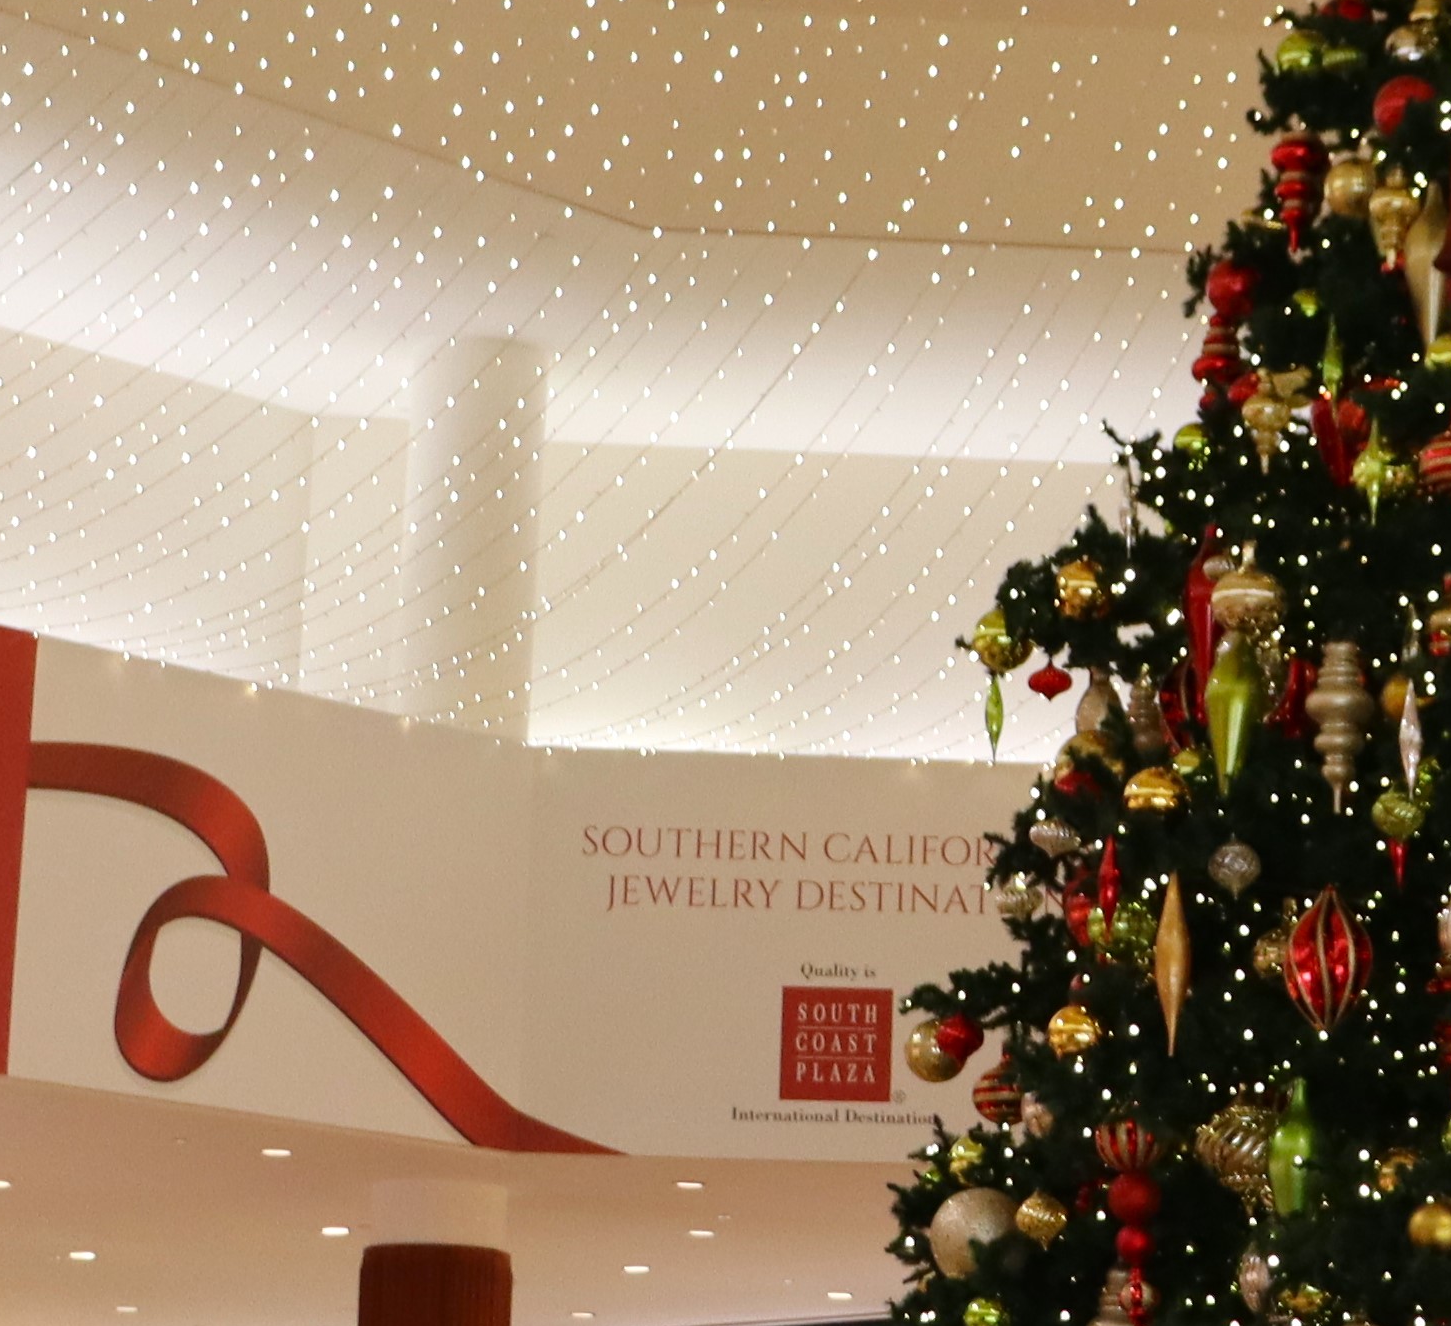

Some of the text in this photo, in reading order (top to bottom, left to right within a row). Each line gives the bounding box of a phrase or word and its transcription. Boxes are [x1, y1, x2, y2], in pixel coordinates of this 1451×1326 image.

[582, 824, 996, 868] SOUTHERN CALIFOR
[606, 874, 1064, 915] JEWELRY DESTINATN
[800, 962, 877, 982] Quality is
[797, 1003, 878, 1024] SOUTH
[795, 1033, 877, 1054] COAST
[795, 1062, 876, 1084] PLAZA
[731, 1106, 840, 1124] International
